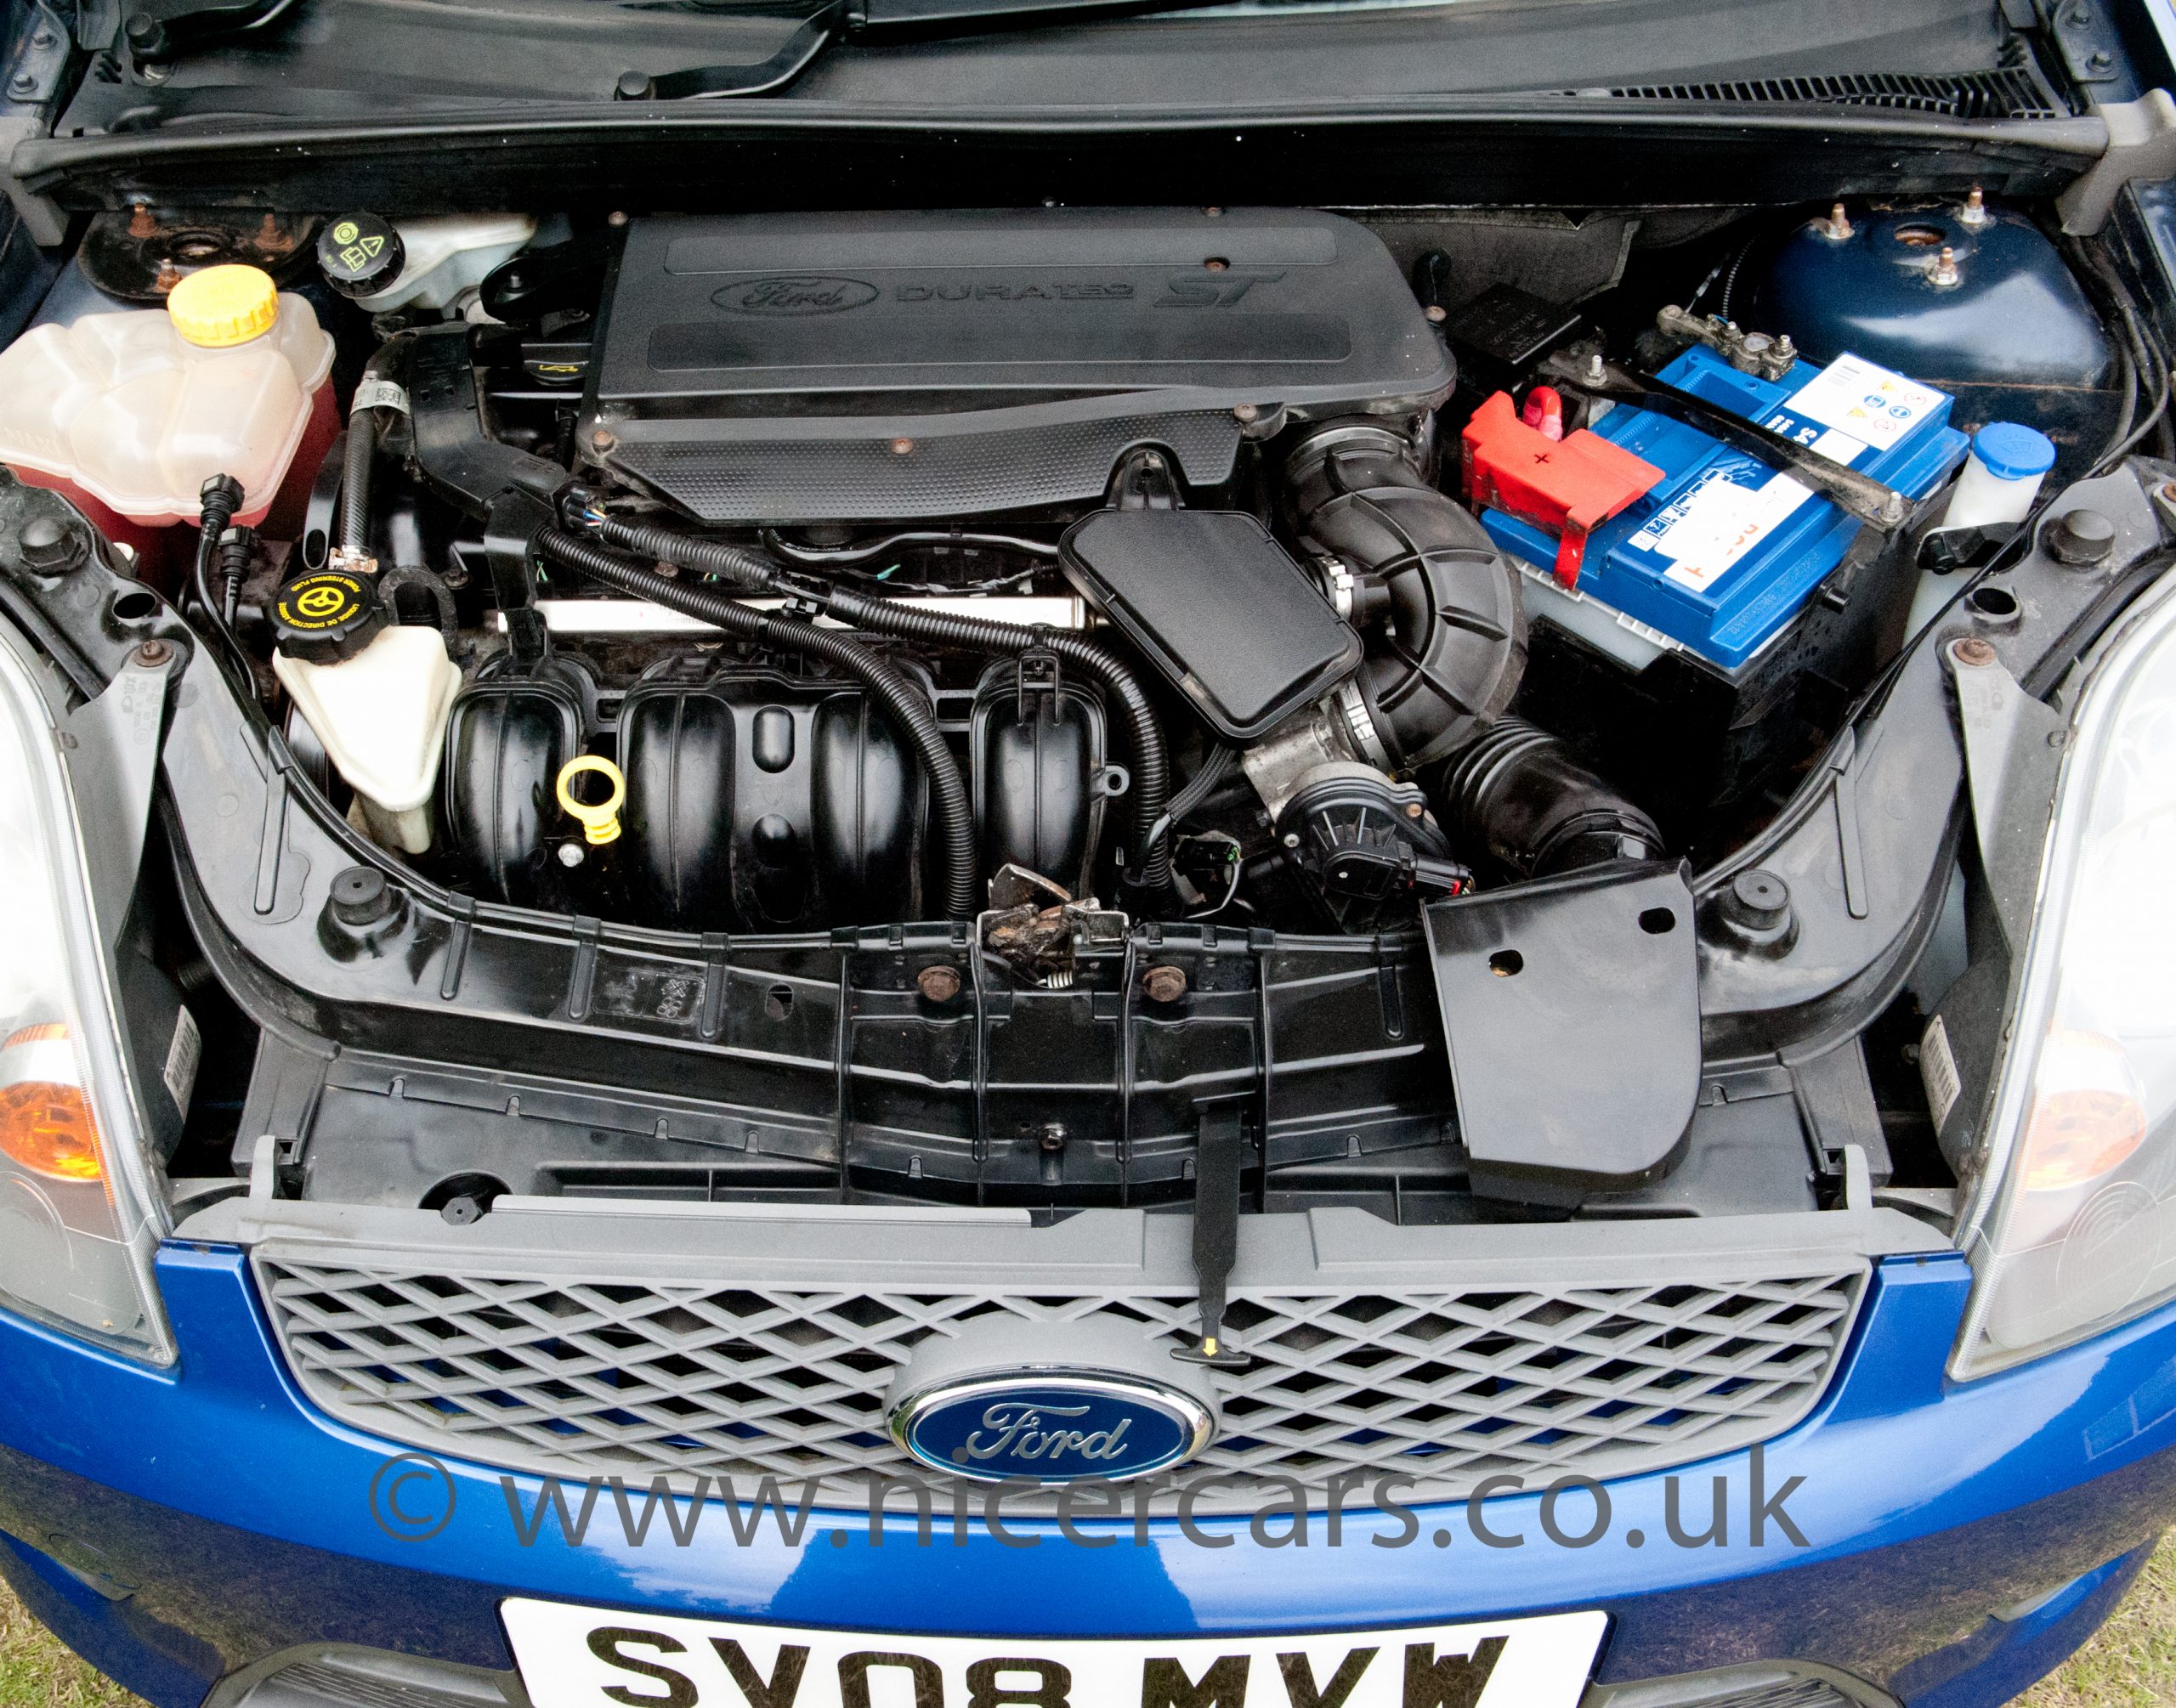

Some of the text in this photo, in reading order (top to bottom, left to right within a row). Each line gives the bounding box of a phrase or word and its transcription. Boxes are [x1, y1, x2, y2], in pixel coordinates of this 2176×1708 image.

[742, 279, 847, 307] Ford
[1153, 271, 1287, 308] ST
[1794, 427, 1817, 444] S4
[291, 580, 310, 591] FLUID
[289, 618, 325, 628] DIRECTION
[966, 1402, 1132, 1459] Ford
